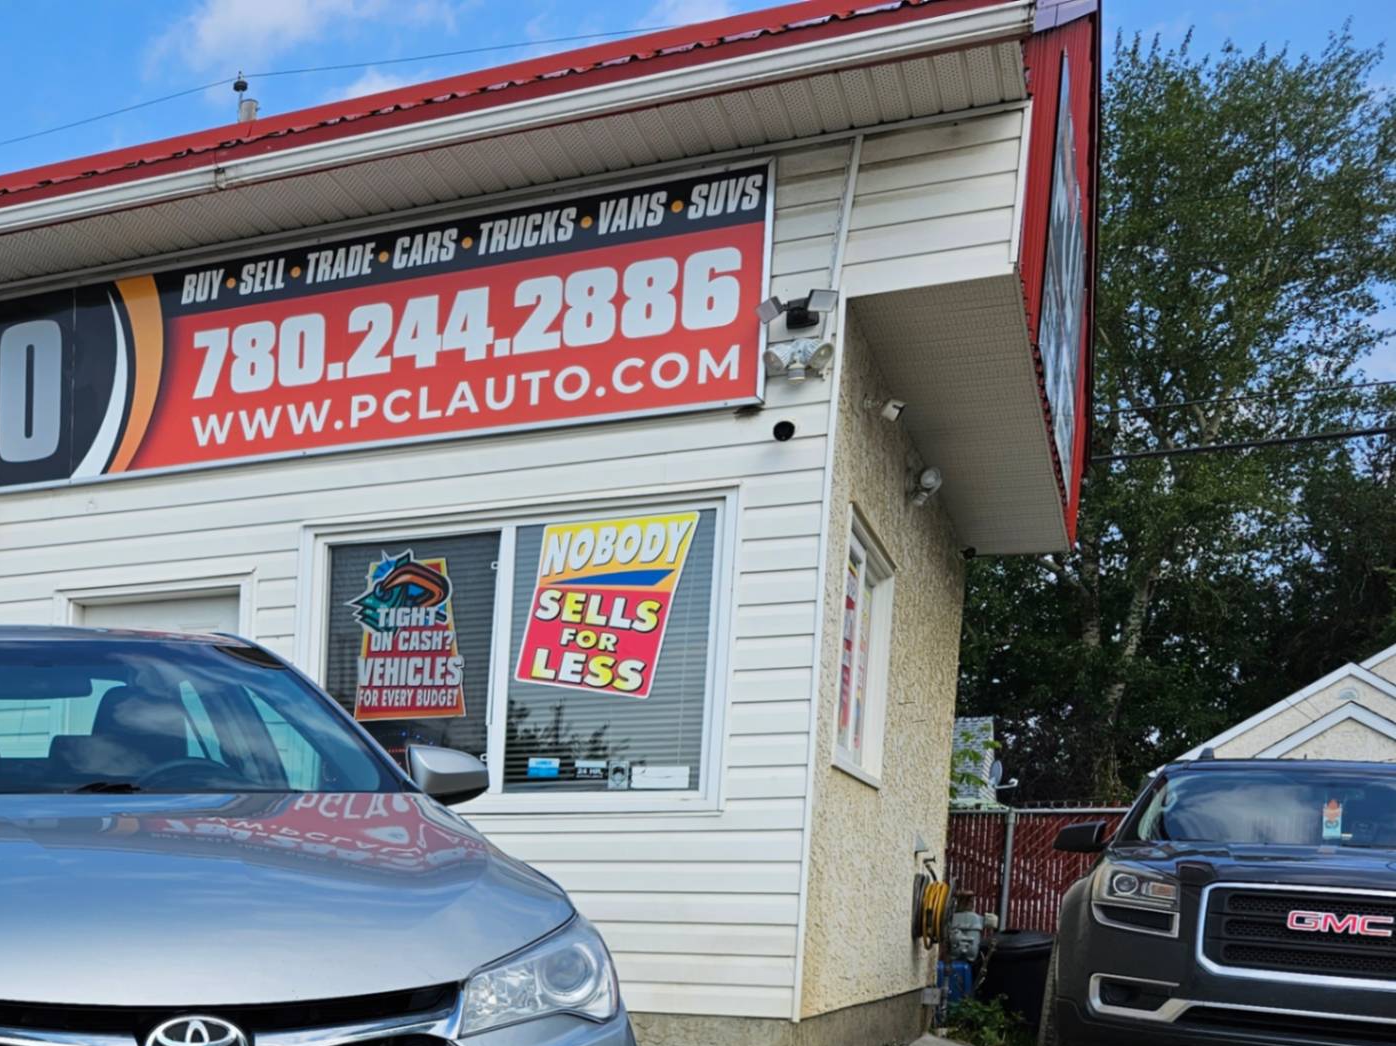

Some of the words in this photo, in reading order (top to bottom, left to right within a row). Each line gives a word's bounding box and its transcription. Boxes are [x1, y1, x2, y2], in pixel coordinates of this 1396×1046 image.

[181, 269, 224, 305] BUY
[238, 258, 285, 295] SELL
[304, 242, 376, 284] TRADE
[391, 227, 456, 269] CARS
[477, 207, 576, 255] TRUCKS
[597, 192, 668, 235] VANS
[686, 173, 764, 221] SUVS
[191, 246, 743, 400] 780.244.2886
[191, 344, 741, 447] WWW.PCLAUTO.COM
[541, 519, 693, 577] NOBODY
[377, 606, 437, 628] TIGHT
[534, 589, 663, 633] SELLS
[370, 631, 394, 651] ON
[398, 630, 455, 651] CASH?
[560, 629, 619, 652] FOR
[357, 655, 464, 686] VEHICLES
[531, 648, 647, 692] LESS
[359, 689, 379, 706] FOR
[381, 688, 415, 706] EVERY
[416, 687, 459, 706] BUDGET
[1287, 910, 1395, 937] GMC
